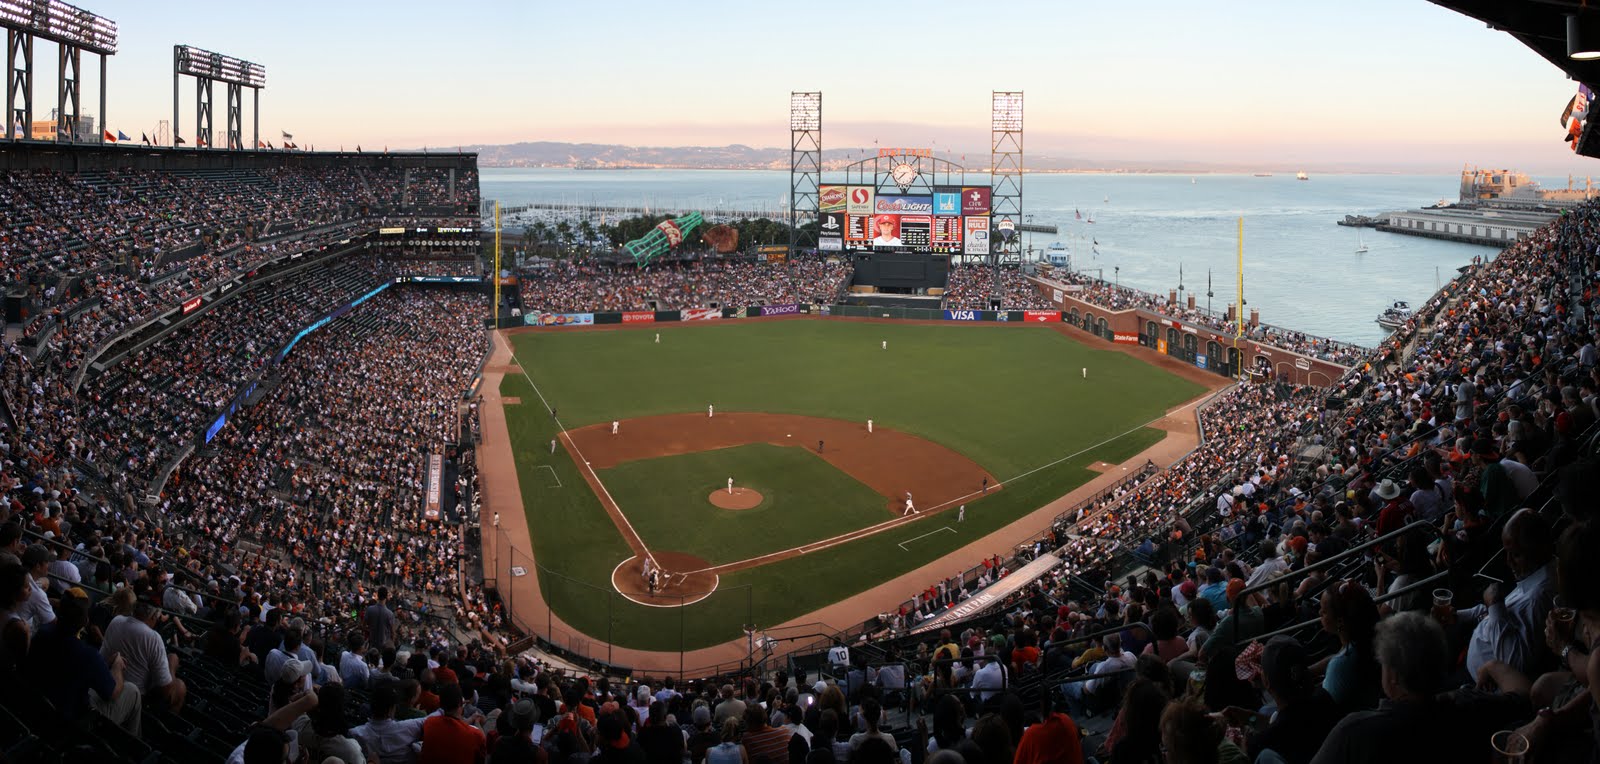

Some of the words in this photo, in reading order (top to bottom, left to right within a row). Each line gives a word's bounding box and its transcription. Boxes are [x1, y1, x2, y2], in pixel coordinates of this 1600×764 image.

[822, 193, 845, 202] DIAMOND
[877, 200, 901, 210] Coors
[902, 201, 931, 211] LIGHT
[763, 305, 798, 315] YAHOO!
[950, 311, 975, 320] VISA
[970, 593, 996, 607] PARK
[836, 651, 847, 661] 10
